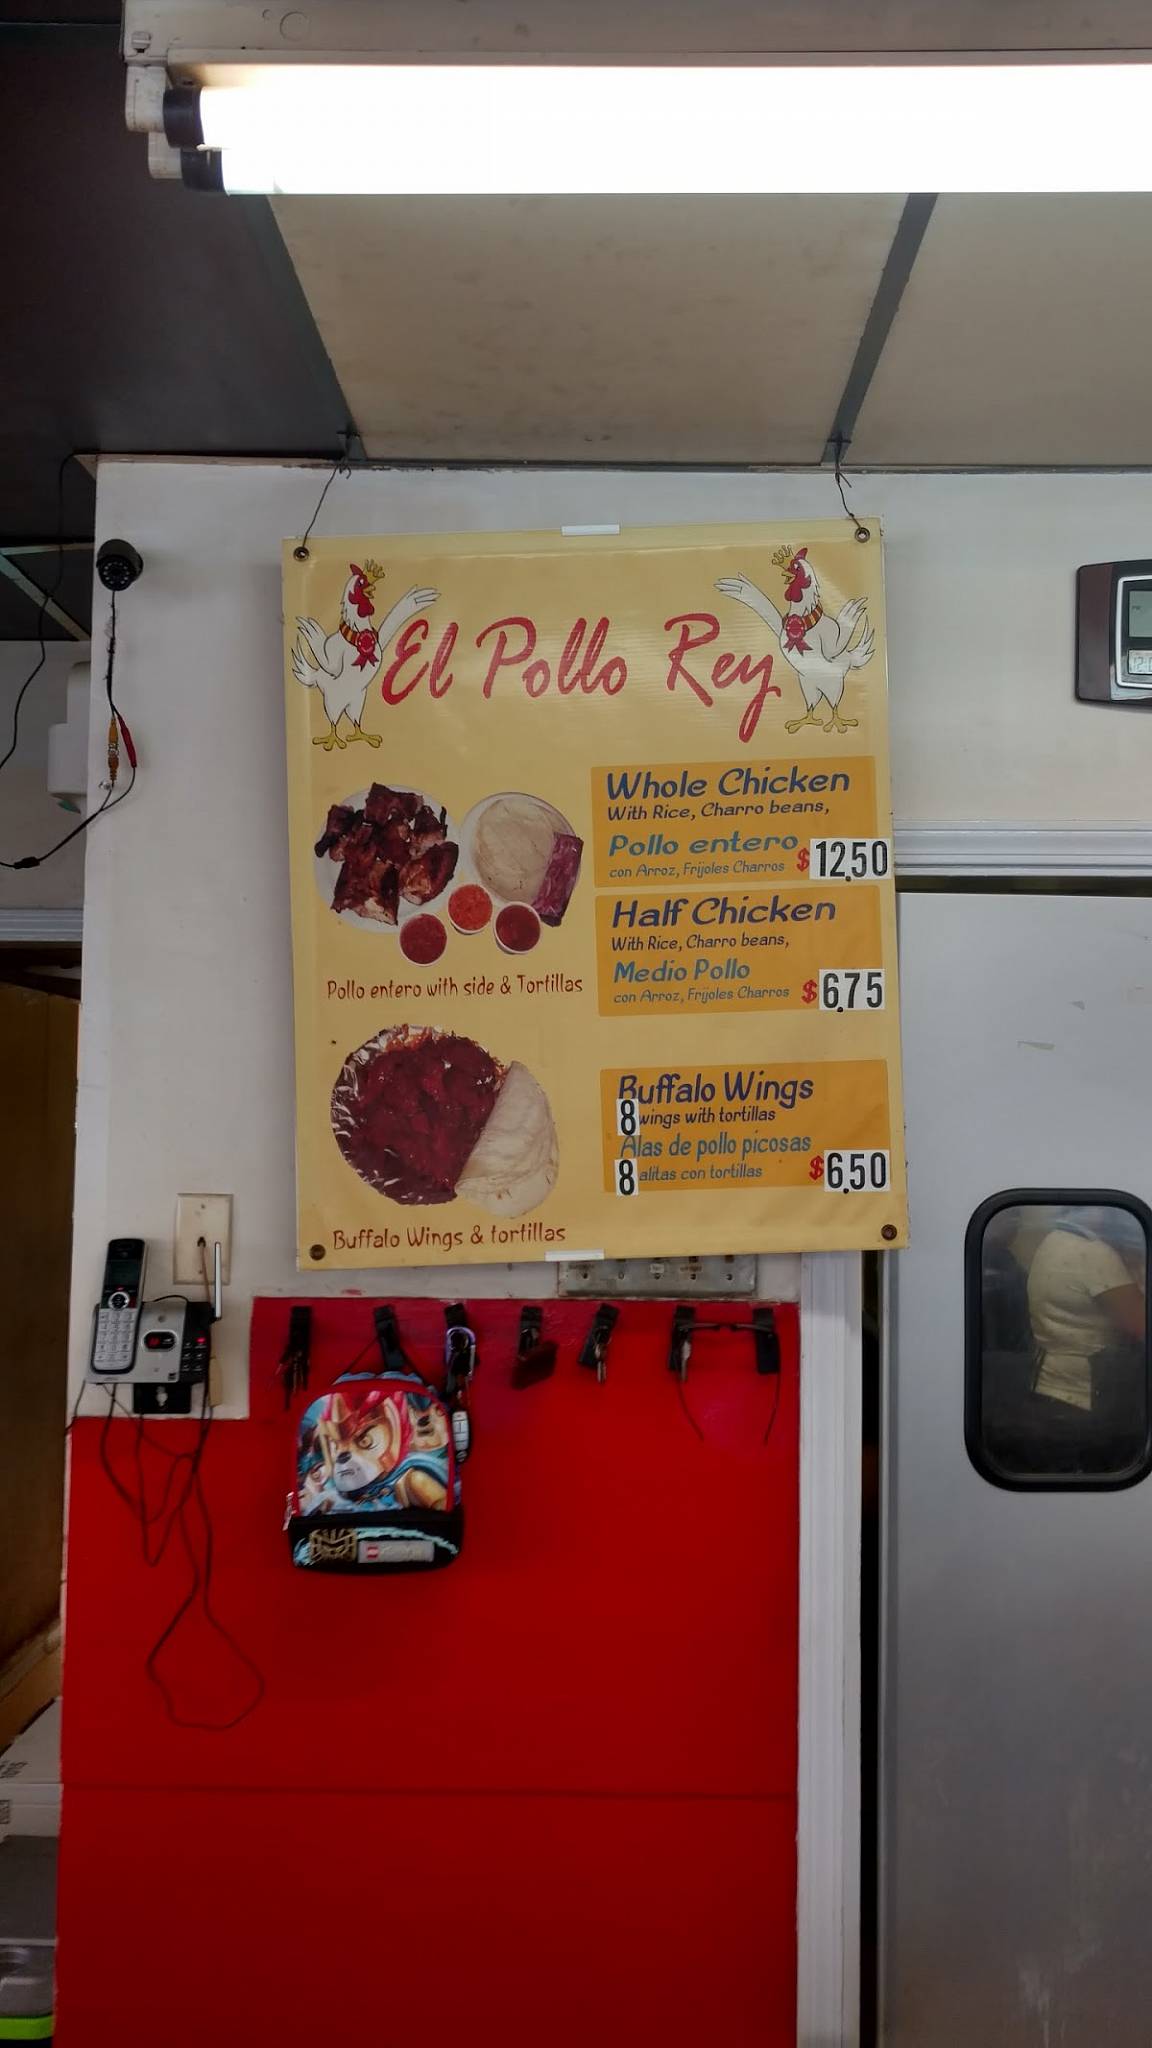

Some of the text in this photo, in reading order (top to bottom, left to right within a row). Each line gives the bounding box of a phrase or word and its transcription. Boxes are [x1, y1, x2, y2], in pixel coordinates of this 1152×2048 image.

[381, 612, 782, 744] El Pollo Rey
[607, 765, 850, 800] Whole Chicken
[608, 800, 830, 821] With Rice, Charro beans,
[609, 831, 799, 856] Pollo entero
[609, 860, 785, 879] con Arroz, Frijoles Charros
[612, 895, 836, 928] Half Chicken
[611, 933, 790, 952] With Rice, Charro beans,
[614, 958, 750, 983] Medio Pollo
[327, 973, 583, 1000] Pollo entero with side & Tortillas
[614, 986, 790, 1004] con Arroz, Frijoles Charros
[618, 1070, 814, 1110] Buffalo Wings
[620, 1099, 776, 1135] 8 wings with tortillas
[620, 1128, 812, 1161] Alas de pollo picosas
[618, 1159, 763, 1195] 8 alitas con tortillas
[333, 1222, 566, 1252] Buffalo Wings & tortillas
